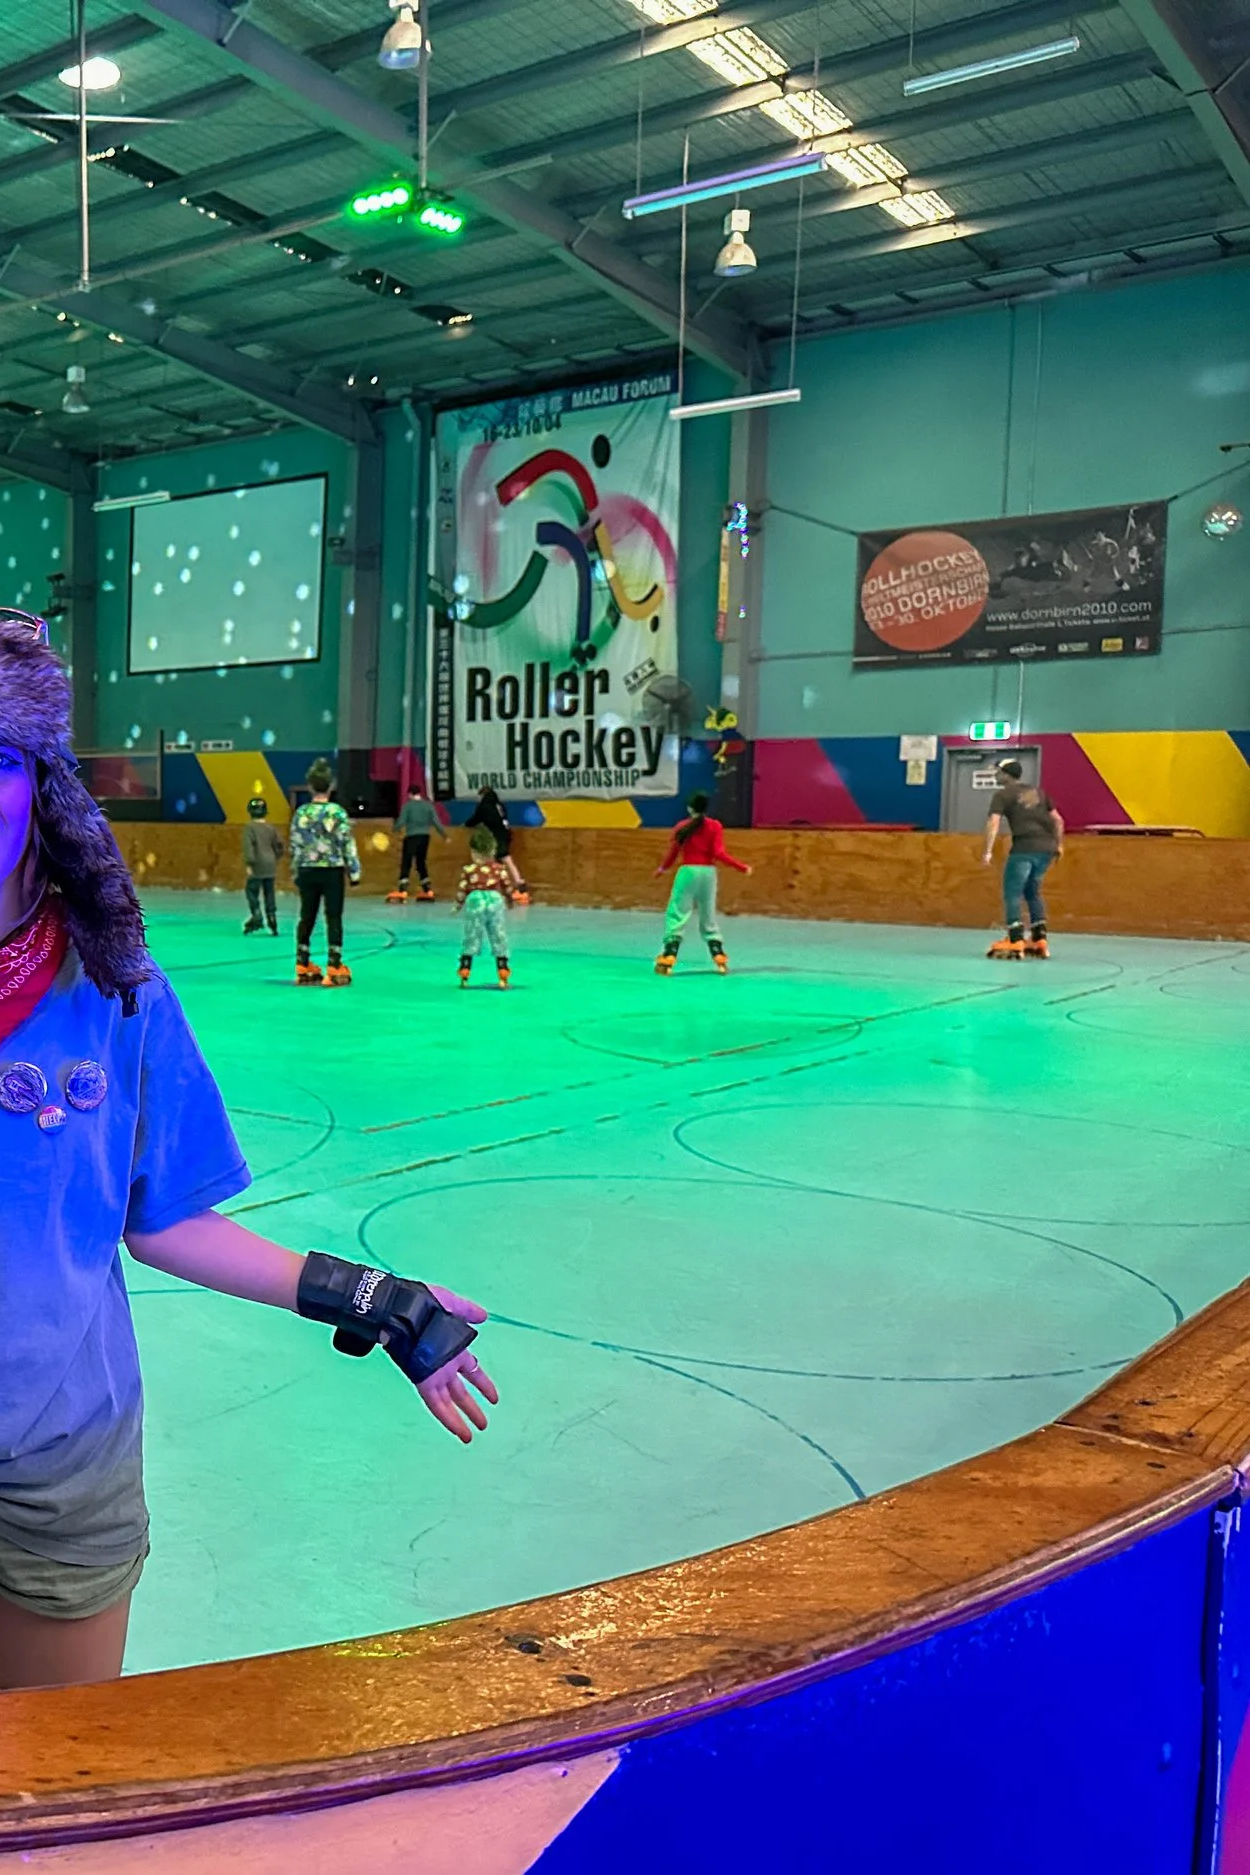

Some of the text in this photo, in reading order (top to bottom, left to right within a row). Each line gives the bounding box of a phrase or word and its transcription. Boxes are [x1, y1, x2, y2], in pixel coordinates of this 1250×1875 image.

[571, 386, 618, 408] MACAU
[622, 375, 671, 400] FORUM
[986, 601, 1152, 622] www.dornbirn2010.com
[466, 661, 609, 722] Roller
[506, 719, 665, 777] Hockey
[467, 769, 641, 790] WORLD CHAMPIONSHIP
